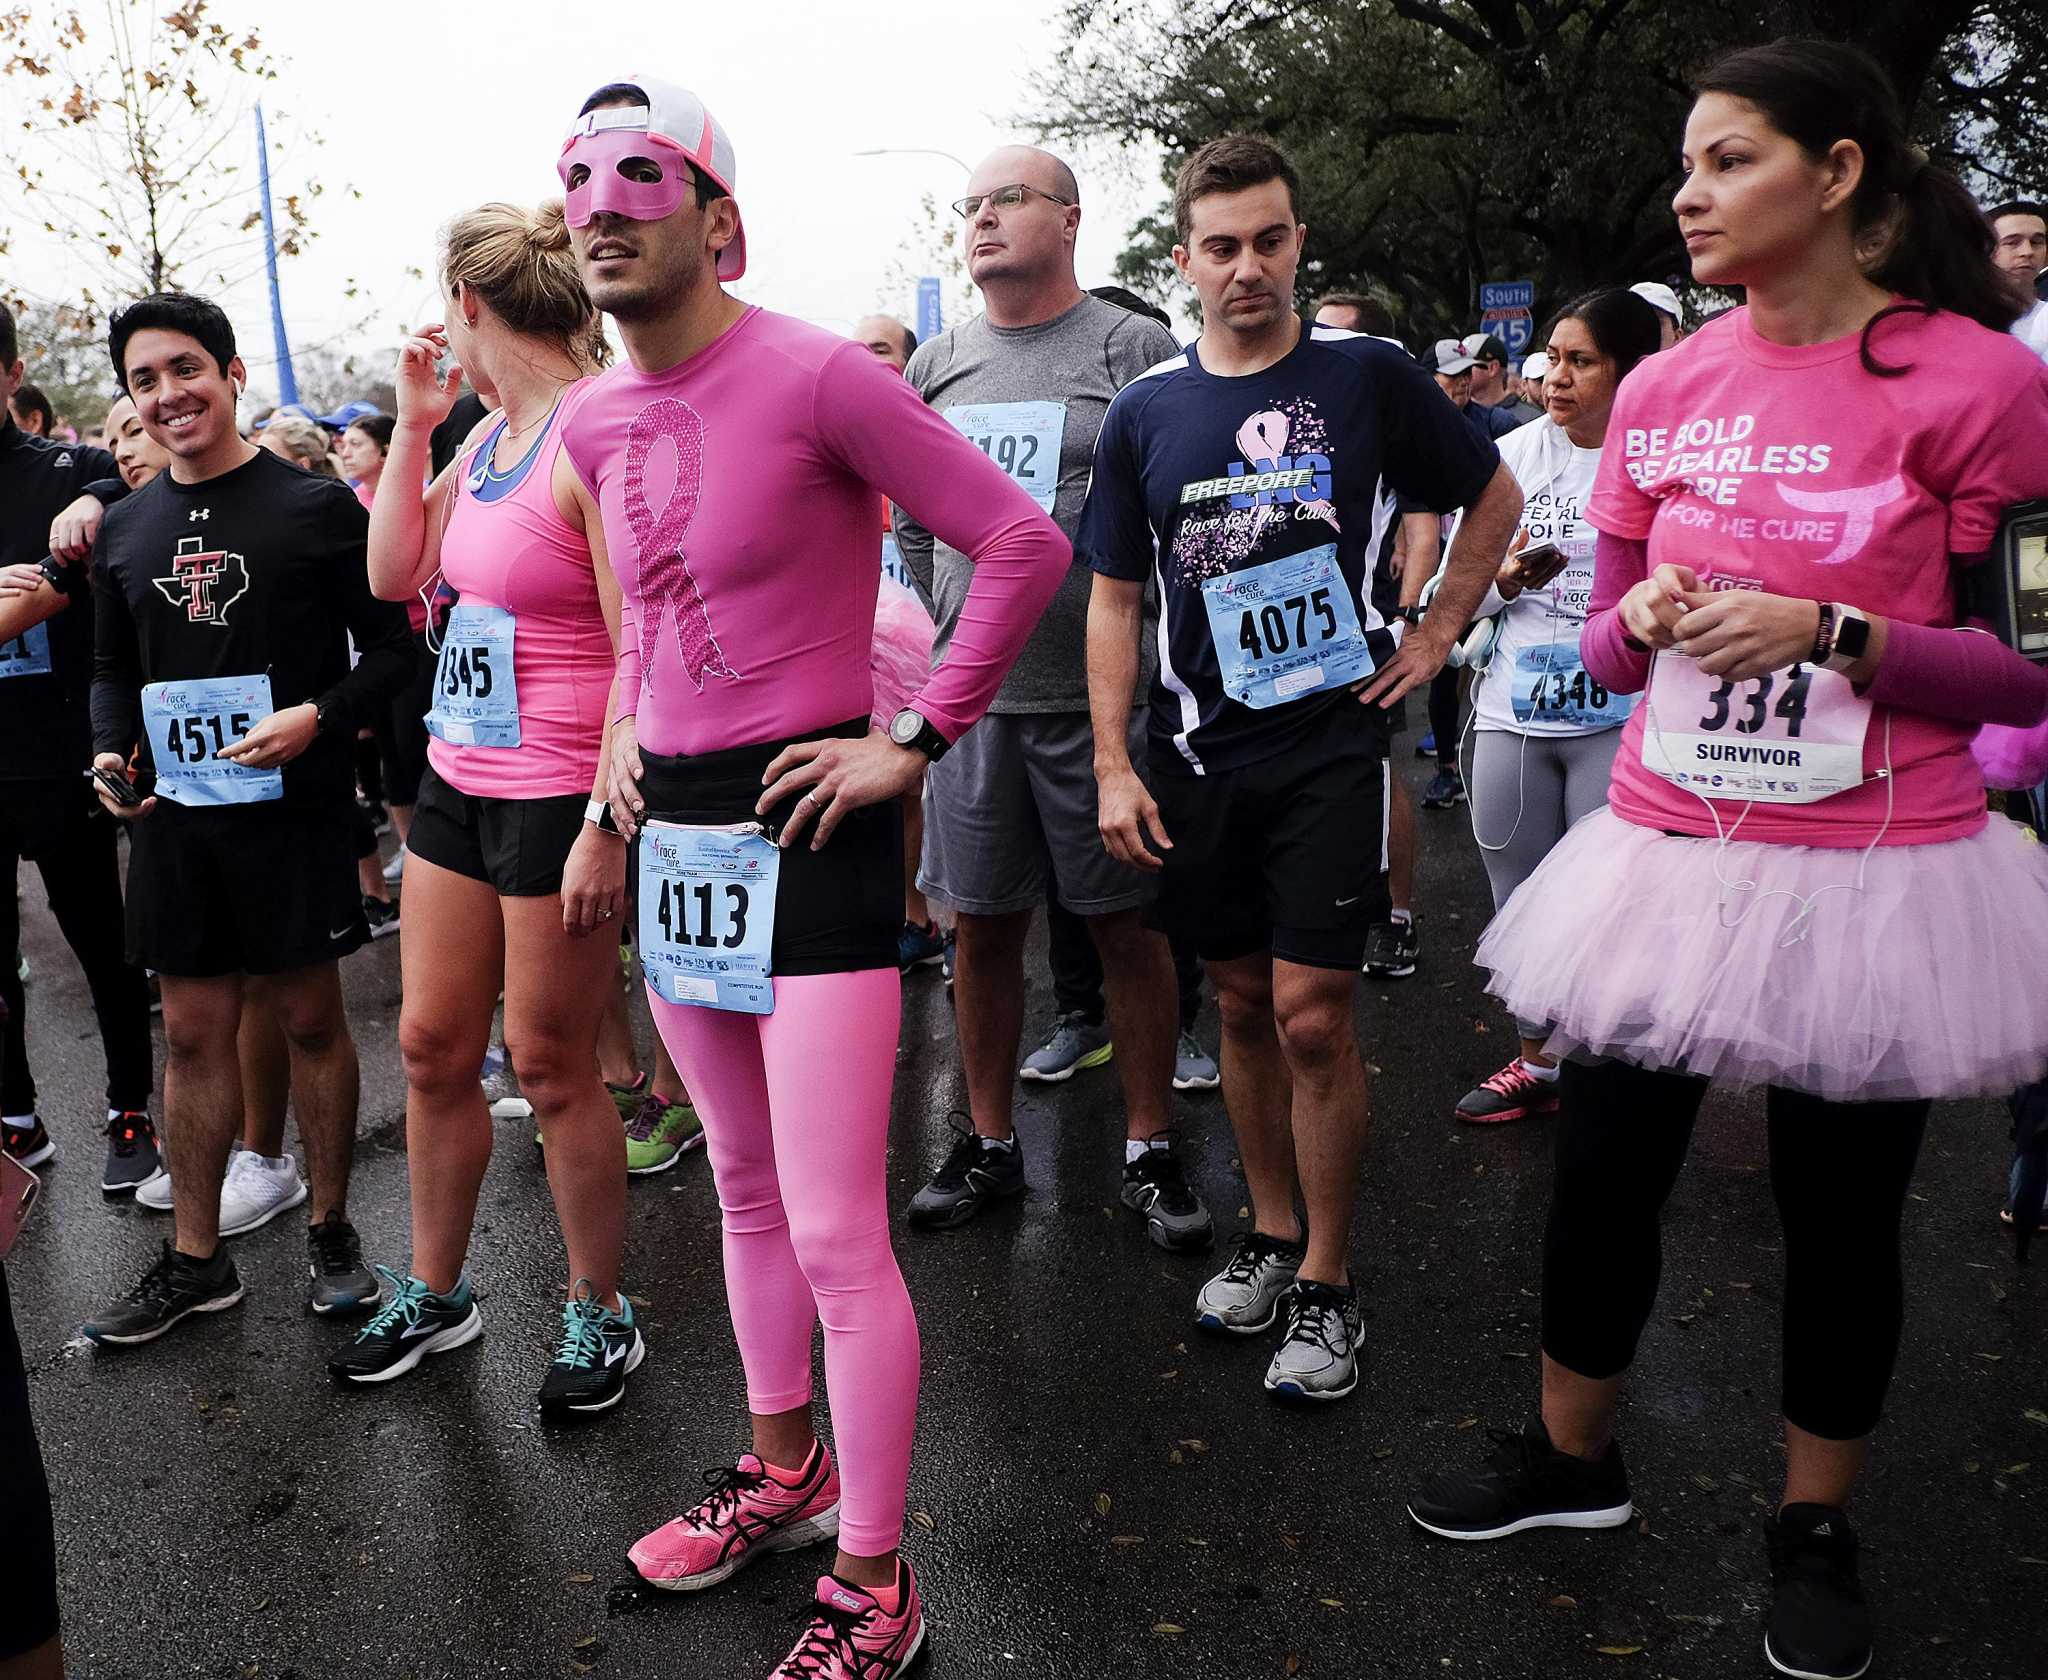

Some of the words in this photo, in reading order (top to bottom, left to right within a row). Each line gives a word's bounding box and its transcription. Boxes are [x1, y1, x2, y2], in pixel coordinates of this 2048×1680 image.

[1485, 287, 1530, 305] SOUTH
[1491, 319, 1526, 349] 45
[1625, 428, 1669, 457] BE
[1672, 415, 1755, 451] BOLD
[967, 434, 1039, 478] 192
[1625, 461, 1662, 489] BE
[1660, 445, 1832, 480] FEARLESS
[1180, 468, 1315, 505] FREEPORT
[1180, 516, 1221, 536] Race
[1294, 504, 1337, 521] Cure
[1665, 503, 1716, 529] FOR
[1761, 518, 1837, 543] CURE
[1234, 581, 1260, 597] race
[1239, 587, 1338, 661] 4075
[1699, 672, 1814, 738] 334
[1696, 743, 1801, 767] SURVIVOR
[659, 846, 677, 859] race
[658, 878, 749, 949] 4113
